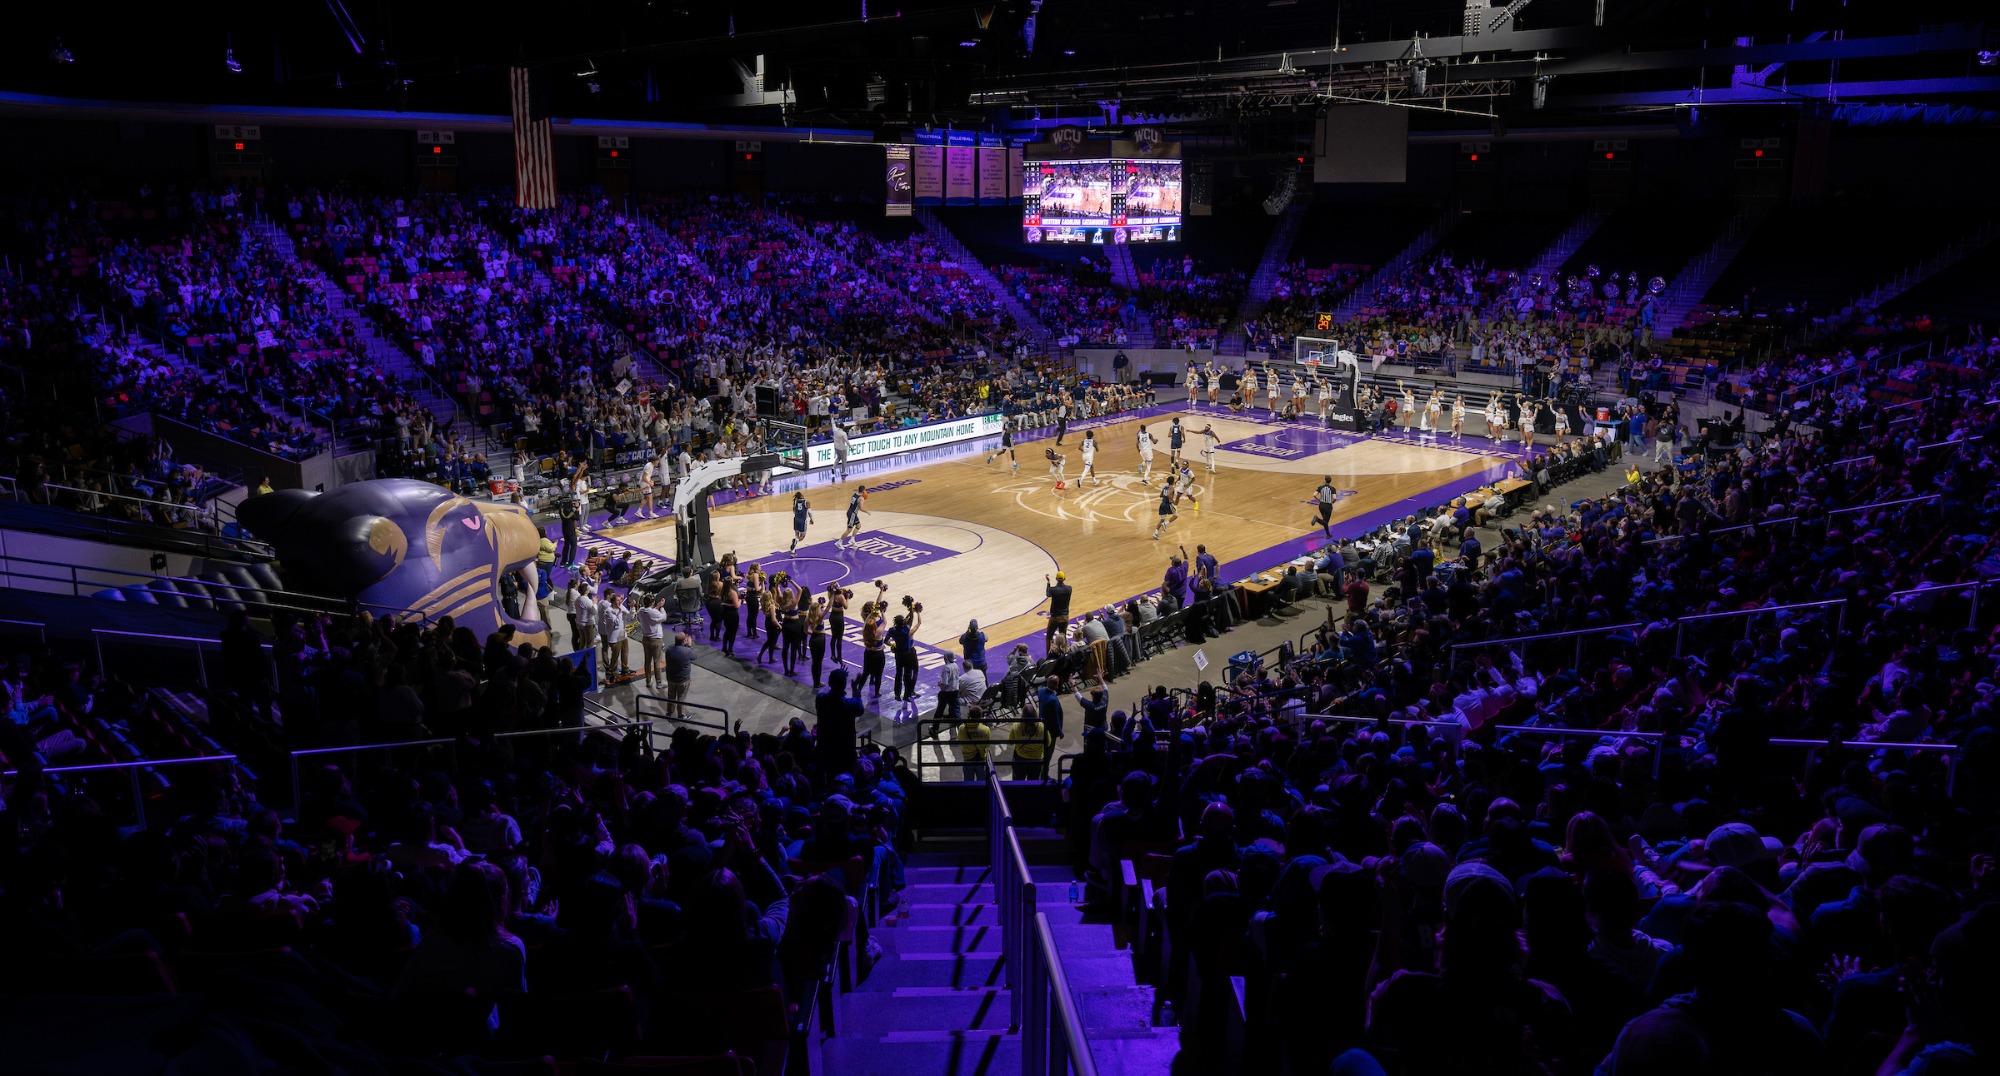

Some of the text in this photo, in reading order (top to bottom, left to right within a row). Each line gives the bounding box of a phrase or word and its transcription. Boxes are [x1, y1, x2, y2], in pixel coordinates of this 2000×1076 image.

[234, 126, 242, 138] S
[433, 132, 439, 142] R
[1052, 129, 1081, 144] WCU
[1135, 128, 1158, 143] WCU
[1332, 412, 1354, 423] ingles
[817, 448, 832, 462] THE
[867, 439, 891, 453] TOUCH
[892, 436, 902, 450] TO
[903, 432, 919, 447] ANY
[919, 427, 954, 443] MOUNTAIN
[956, 423, 975, 436] HOME
[631, 450, 646, 461] CAT
